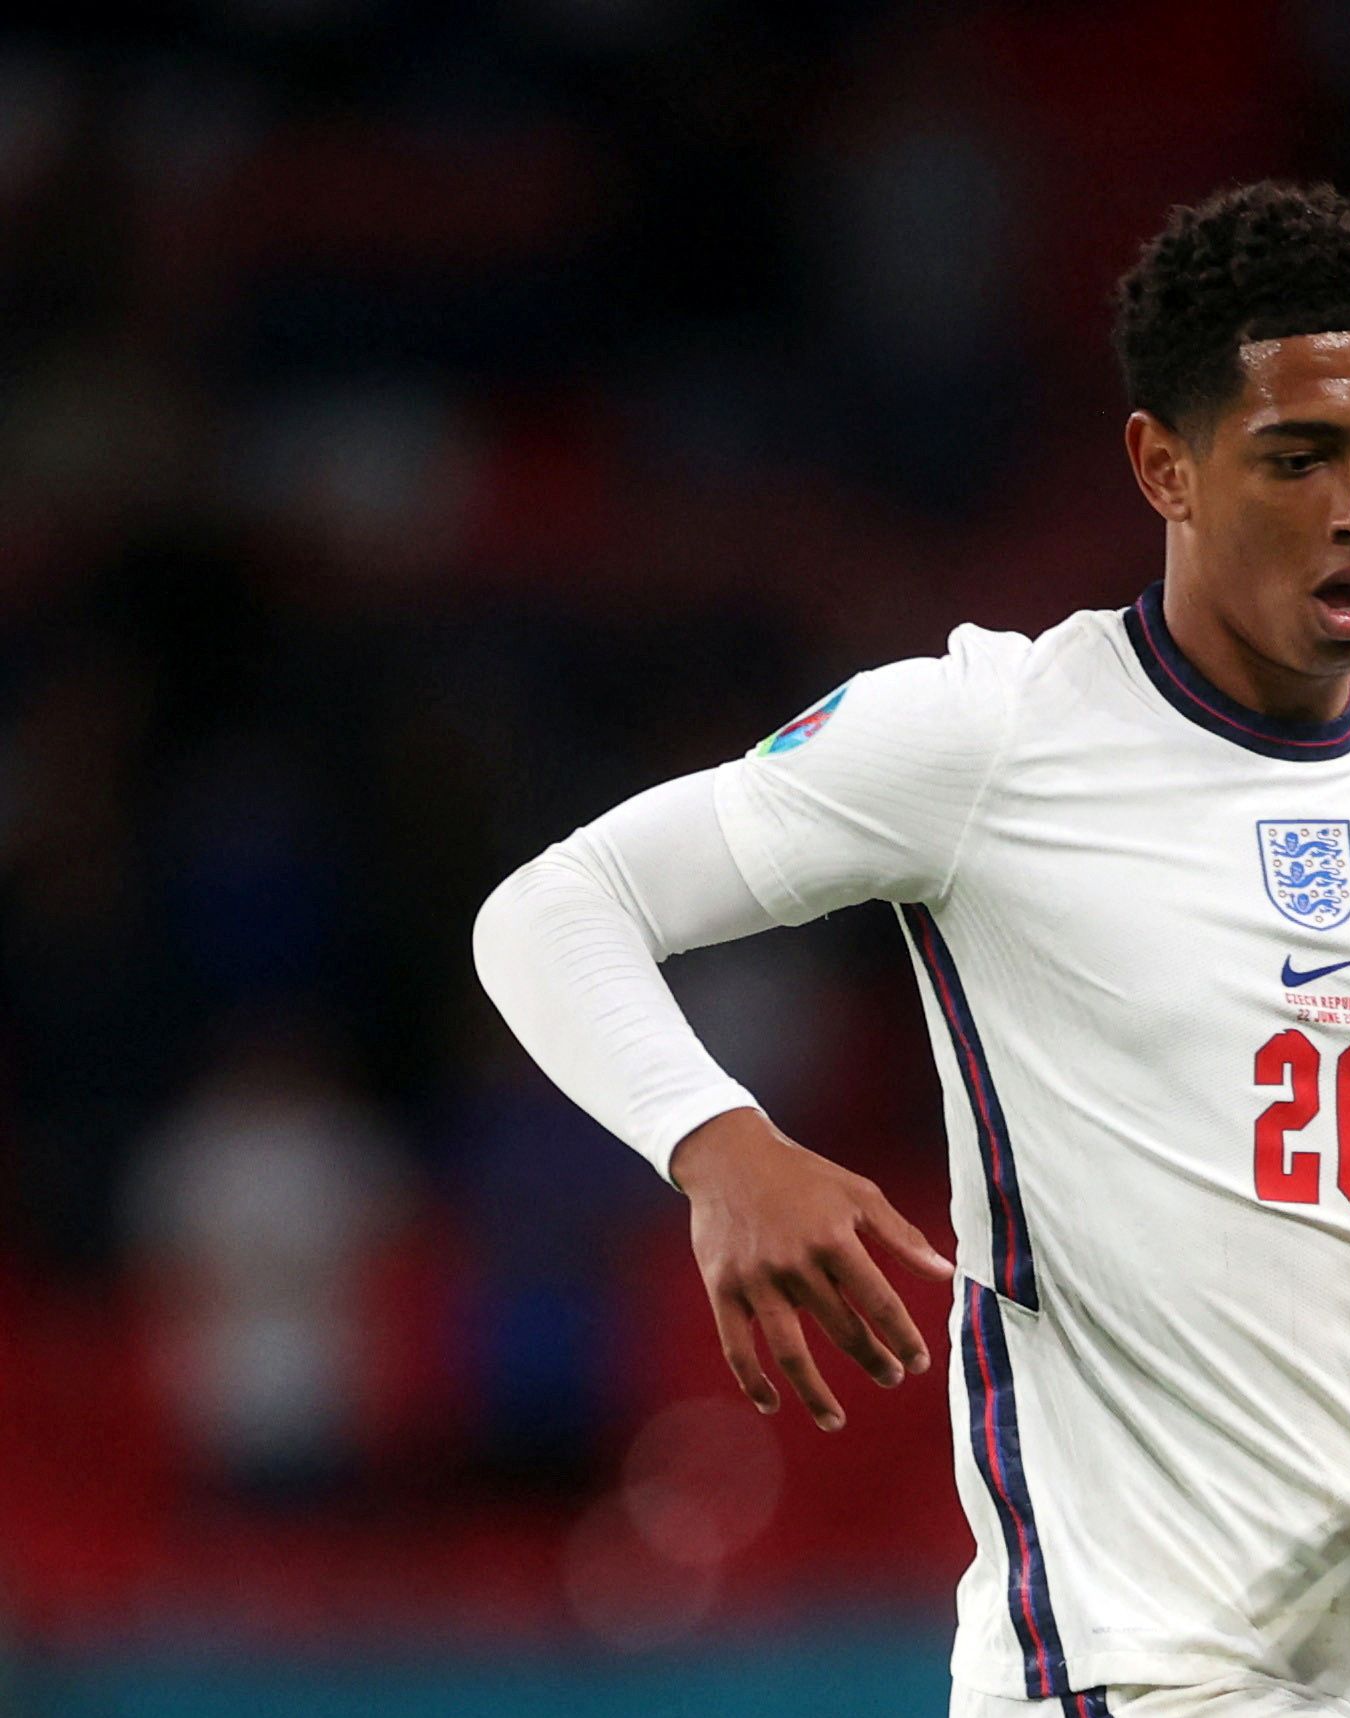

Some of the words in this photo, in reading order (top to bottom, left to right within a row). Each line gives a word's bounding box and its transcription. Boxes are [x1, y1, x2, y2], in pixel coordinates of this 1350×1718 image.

[1285, 992, 1317, 1007] CZECH
[1296, 1009, 1310, 1022] 22
[1314, 1010, 1341, 1024] JUNE
